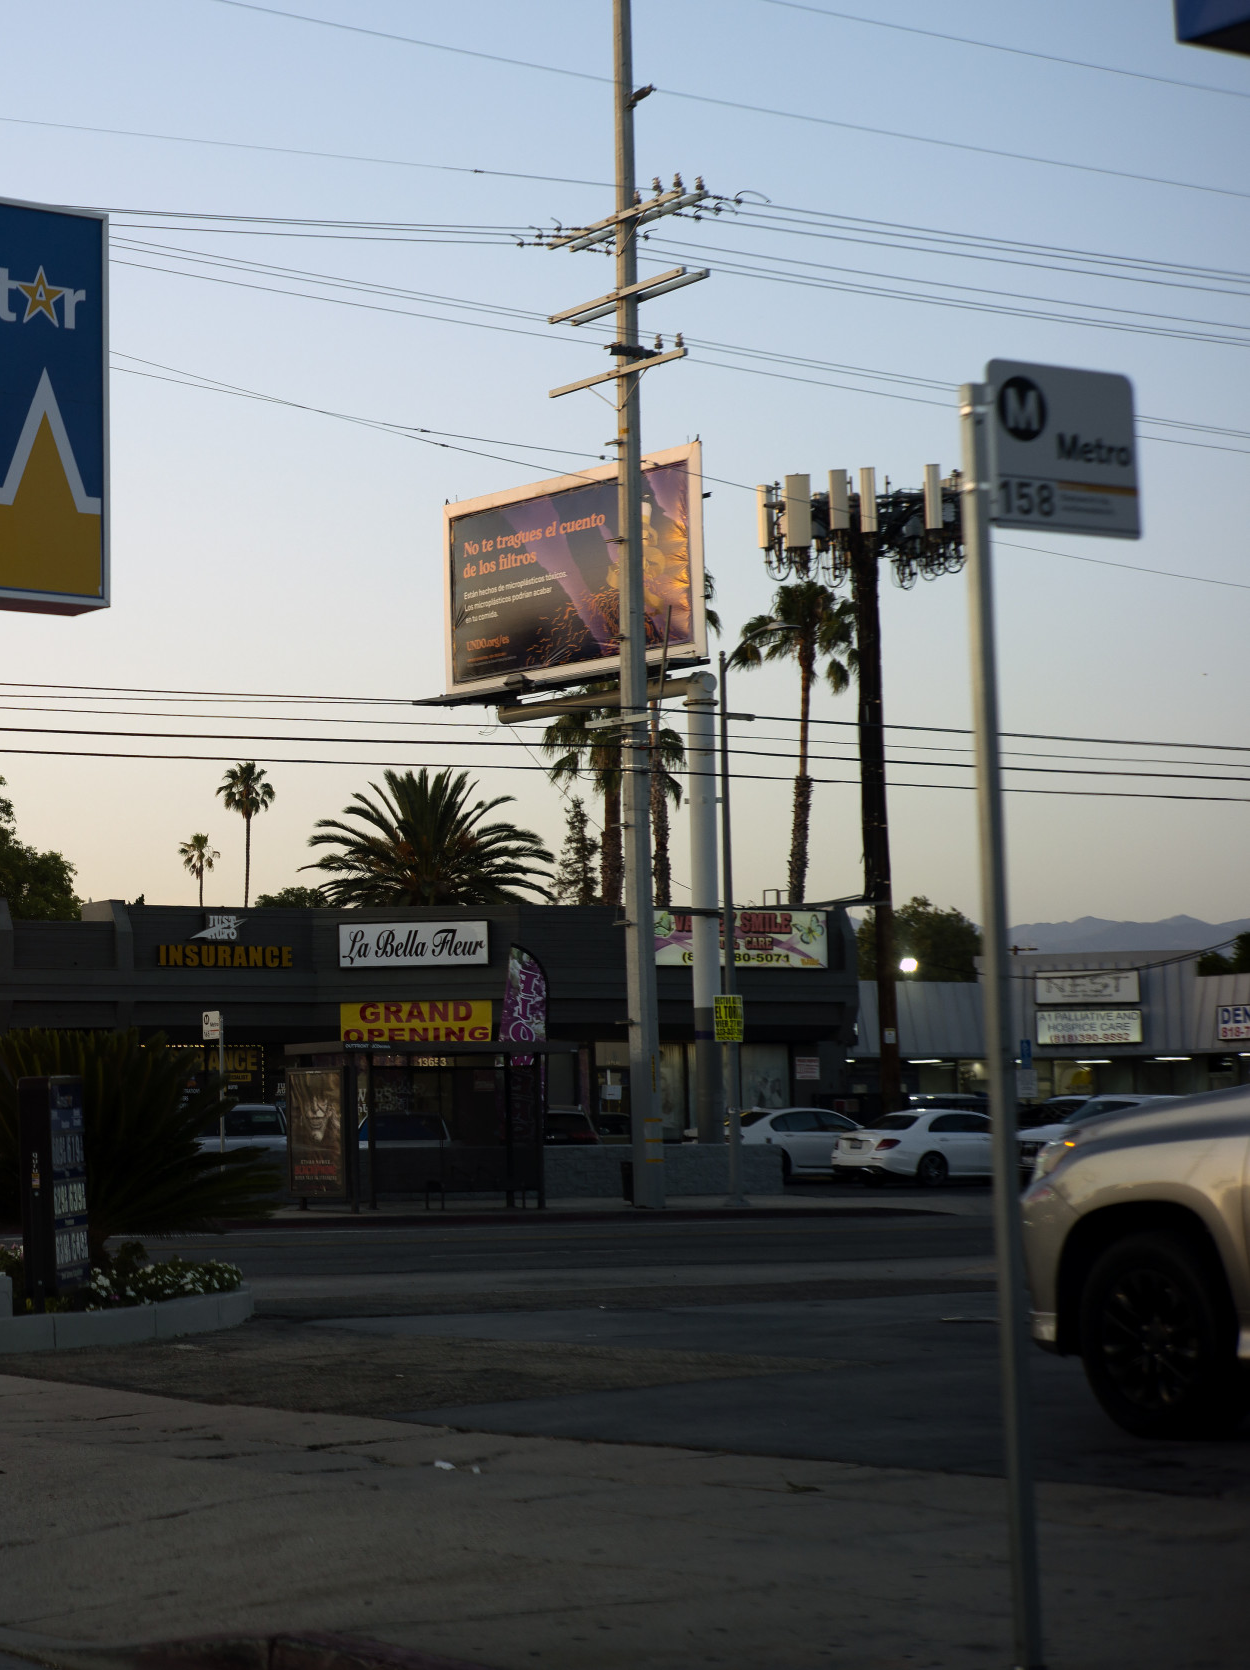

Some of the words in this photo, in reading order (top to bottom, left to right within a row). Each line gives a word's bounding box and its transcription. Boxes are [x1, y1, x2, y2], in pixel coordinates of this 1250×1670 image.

[1057, 432, 1132, 466] Metro
[1000, 480, 1055, 517] 158
[463, 541, 480, 558] No
[481, 535, 495, 552] te
[496, 526, 543, 549] tragues
[545, 521, 557, 538] el
[559, 512, 606, 535] cuento
[463, 563, 477, 579] de
[479, 559, 496, 576] los
[498, 551, 537, 571] filtros
[498, 584, 505, 592] de
[464, 603, 474, 612] Los
[533, 586, 553, 597] acabar
[466, 634, 510, 651] UNDO.org/es
[208, 915, 236, 928] JUST
[741, 913, 792, 934] SMILE
[342, 929, 371, 965] La
[375, 928, 428, 959] Bella
[433, 928, 486, 958] Fleur
[745, 937, 774, 950] CARE
[158, 944, 294, 968] INSURANCE
[733, 953, 790, 963] 80-5071
[359, 1002, 473, 1024] GRAND
[1055, 1012, 1114, 1021] PALLIATIVE
[1116, 1012, 1139, 1020] AND
[342, 1026, 490, 1042] OPENING
[1048, 1022, 1097, 1032] HOSPICE
[1100, 1022, 1131, 1031] CARE
